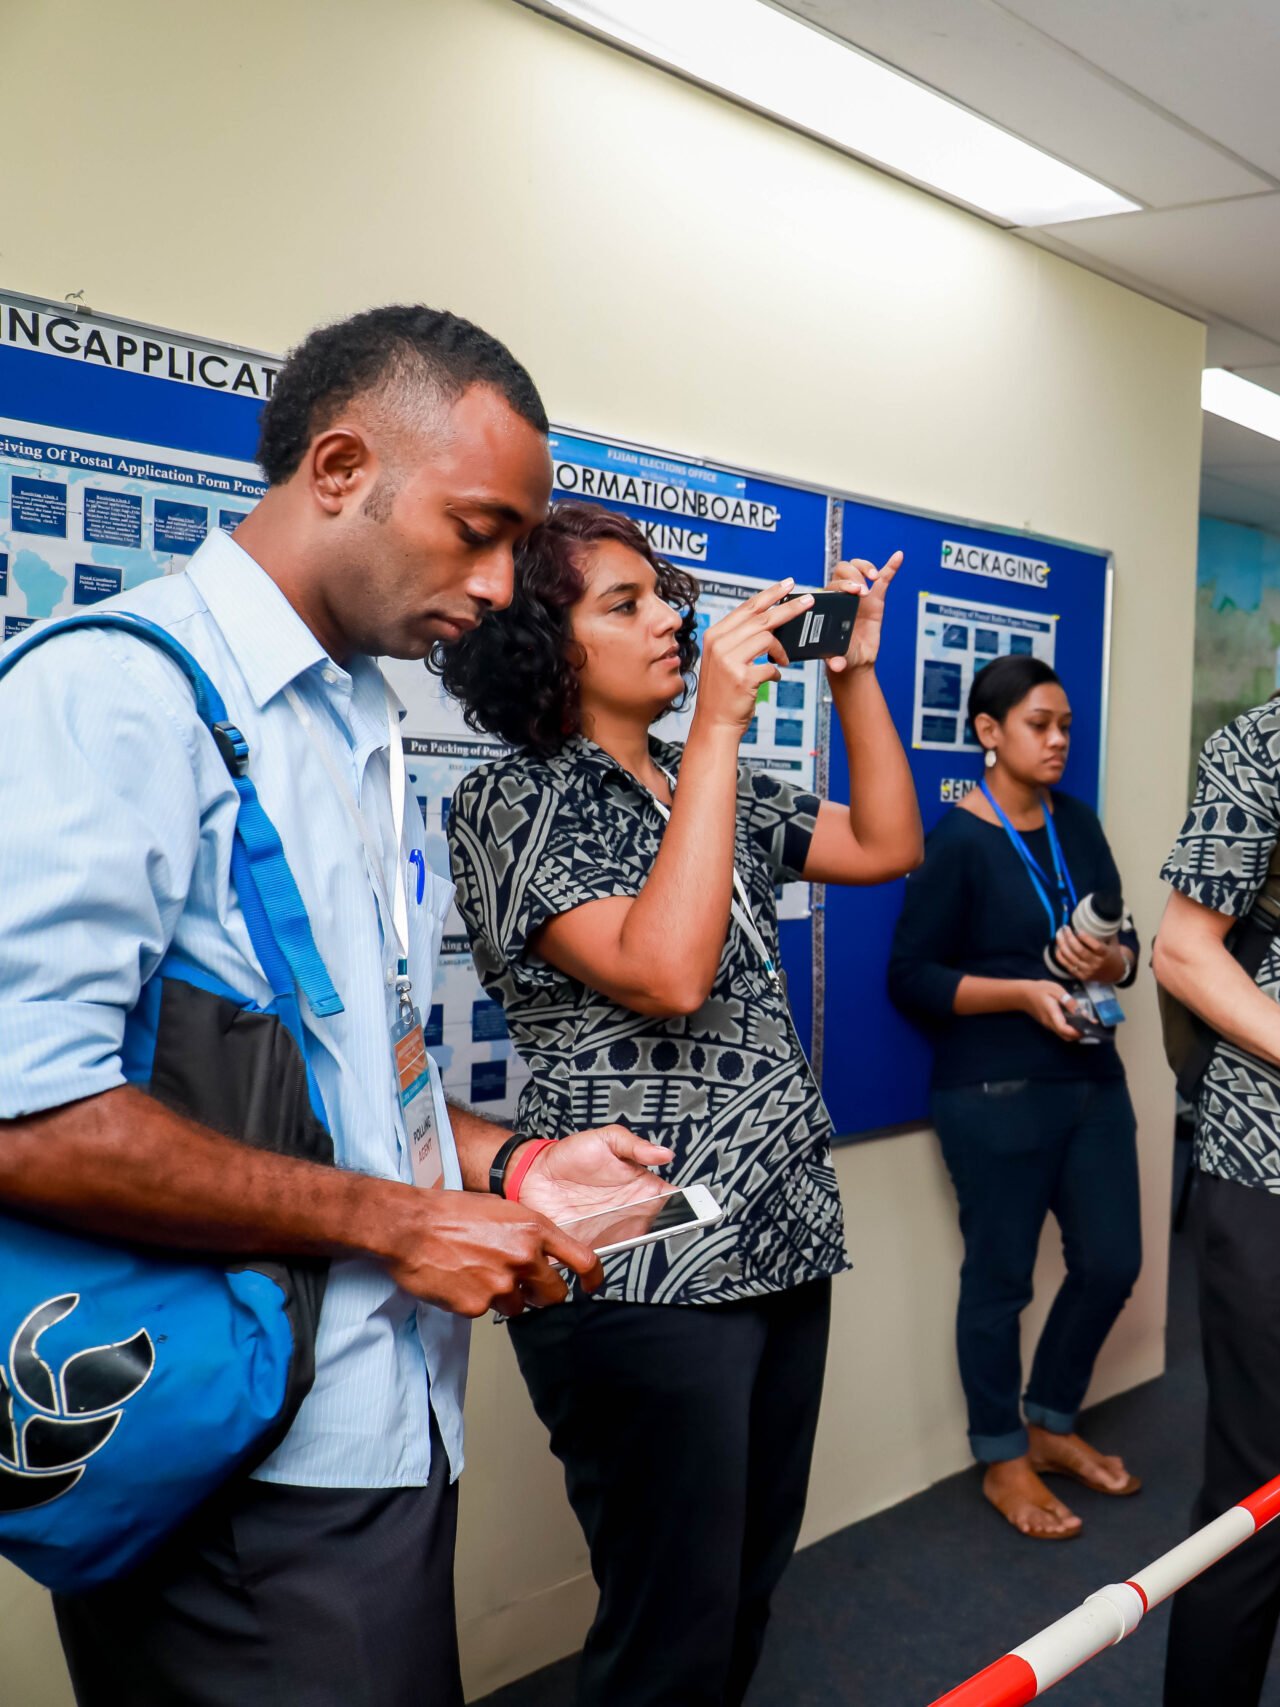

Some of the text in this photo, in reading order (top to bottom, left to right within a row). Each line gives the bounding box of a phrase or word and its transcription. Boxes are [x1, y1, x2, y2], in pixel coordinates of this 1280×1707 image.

[46, 447, 68, 462] Of
[70, 452, 113, 470] Postal
[117, 459, 193, 483] Application
[197, 474, 230, 490] Form
[234, 480, 269, 496] Proce
[688, 468, 717, 483] OFFICE
[638, 519, 705, 555] KING
[944, 544, 1047, 584] PACKAGING
[411, 740, 428, 752] Pre
[430, 741, 469, 757] Packing
[470, 746, 480, 755] of
[441, 941, 462, 953] king
[413, 1115, 432, 1145] POLLING
[418, 1137, 432, 1165] AGENT
